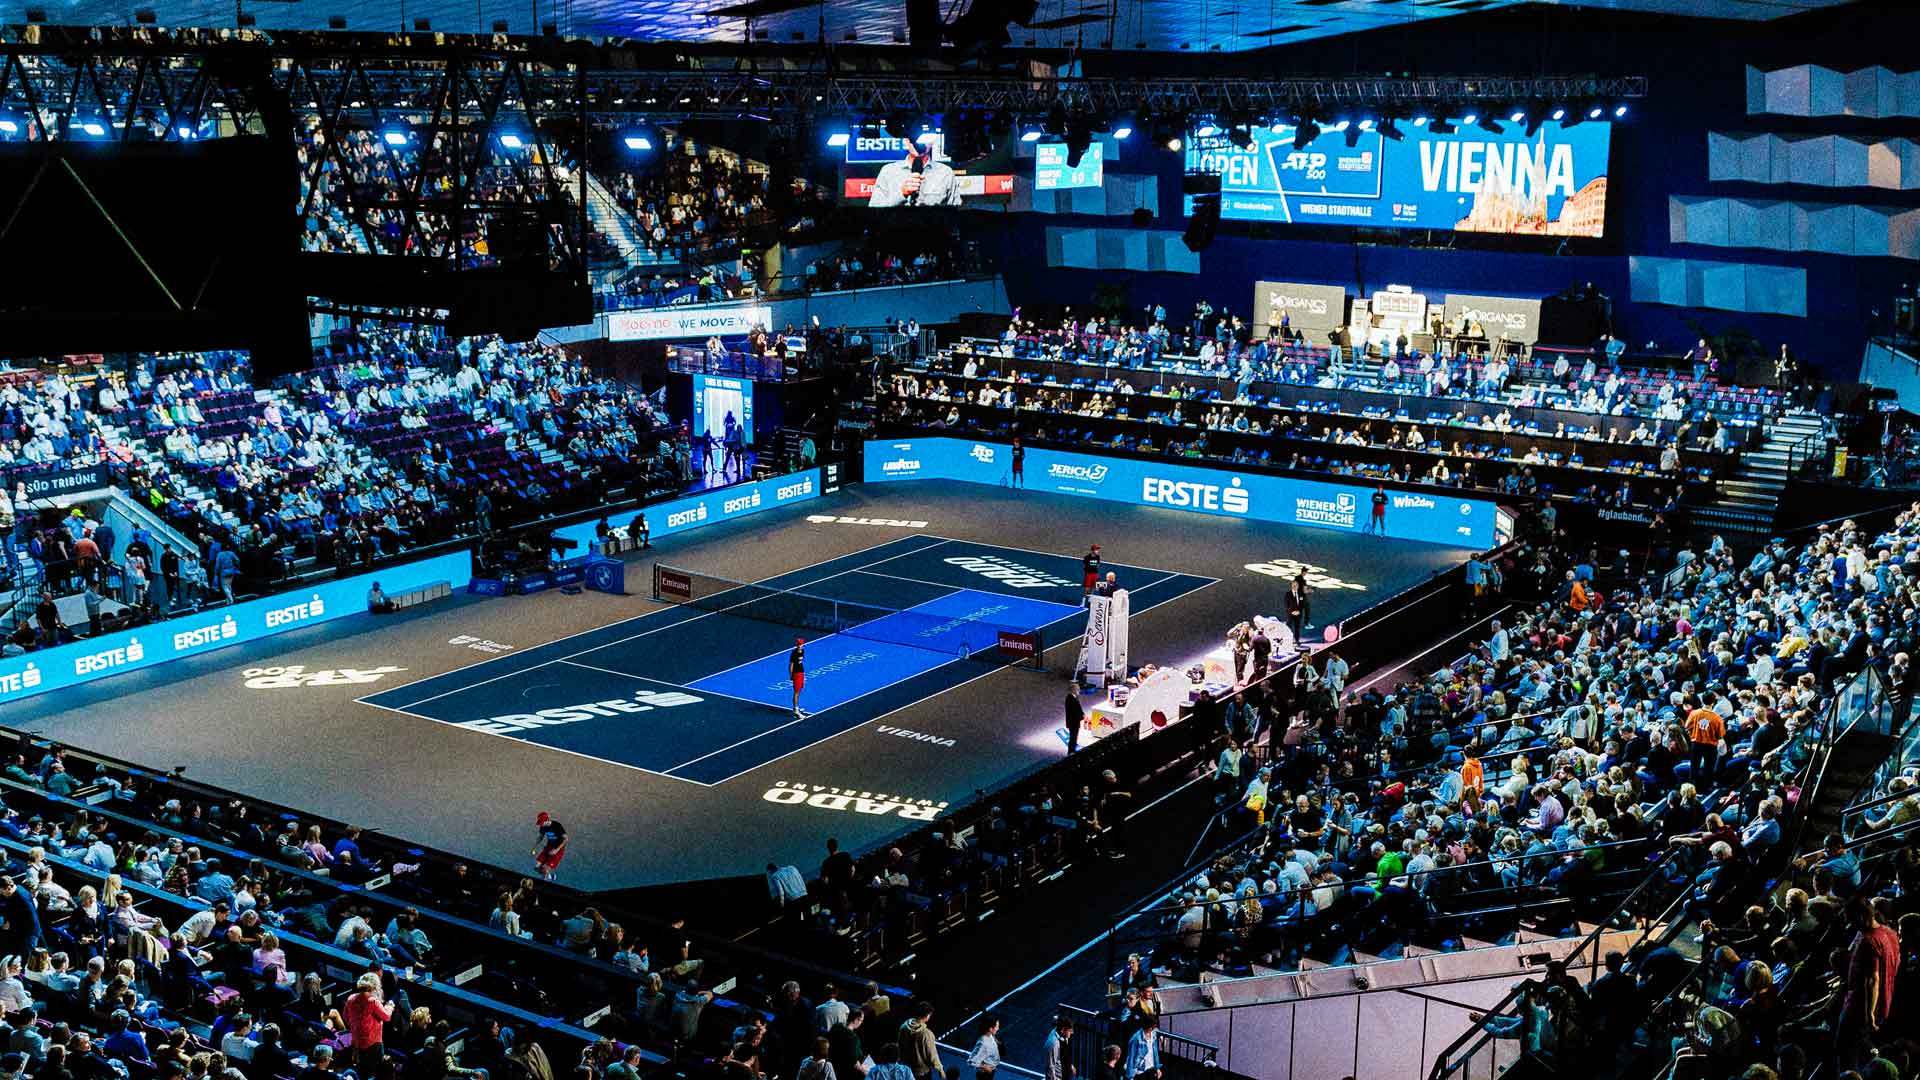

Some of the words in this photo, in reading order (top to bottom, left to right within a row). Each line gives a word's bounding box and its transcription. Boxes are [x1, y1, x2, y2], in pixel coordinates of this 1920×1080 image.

[856, 137, 899, 150] ERSTE
[1281, 152, 1327, 170] ATP
[1419, 140, 1575, 197] VIENNA
[1306, 170, 1326, 179] 500
[1301, 203, 1328, 214] WIENER
[1328, 205, 1372, 216] STADTHALLE
[678, 319, 697, 329] WE
[700, 317, 734, 327] MOVE
[1048, 464, 1091, 477] JERICH
[27, 480, 49, 493] SÜD
[52, 473, 97, 489] TRIBÜNE
[777, 486, 801, 500] ERSTE
[1143, 477, 1219, 511] ERSTE
[724, 498, 750, 514] ERSTE
[1296, 498, 1336, 512] WIENER
[668, 510, 696, 527] ERSTE
[1296, 509, 1355, 525] STÄDTISCHE
[662, 577, 689, 592] Emirates
[266, 606, 308, 628] ERSTE
[174, 627, 220, 650] ERSTE
[1000, 638, 1033, 651] Emirates
[75, 648, 125, 675] ERSTE
[241, 666, 305, 679] 500
[450, 699, 654, 735] ERSTE
[877, 725, 957, 748] VIENNA
[775, 780, 949, 809] SWITZERLAND
[763, 788, 943, 821] RADO
